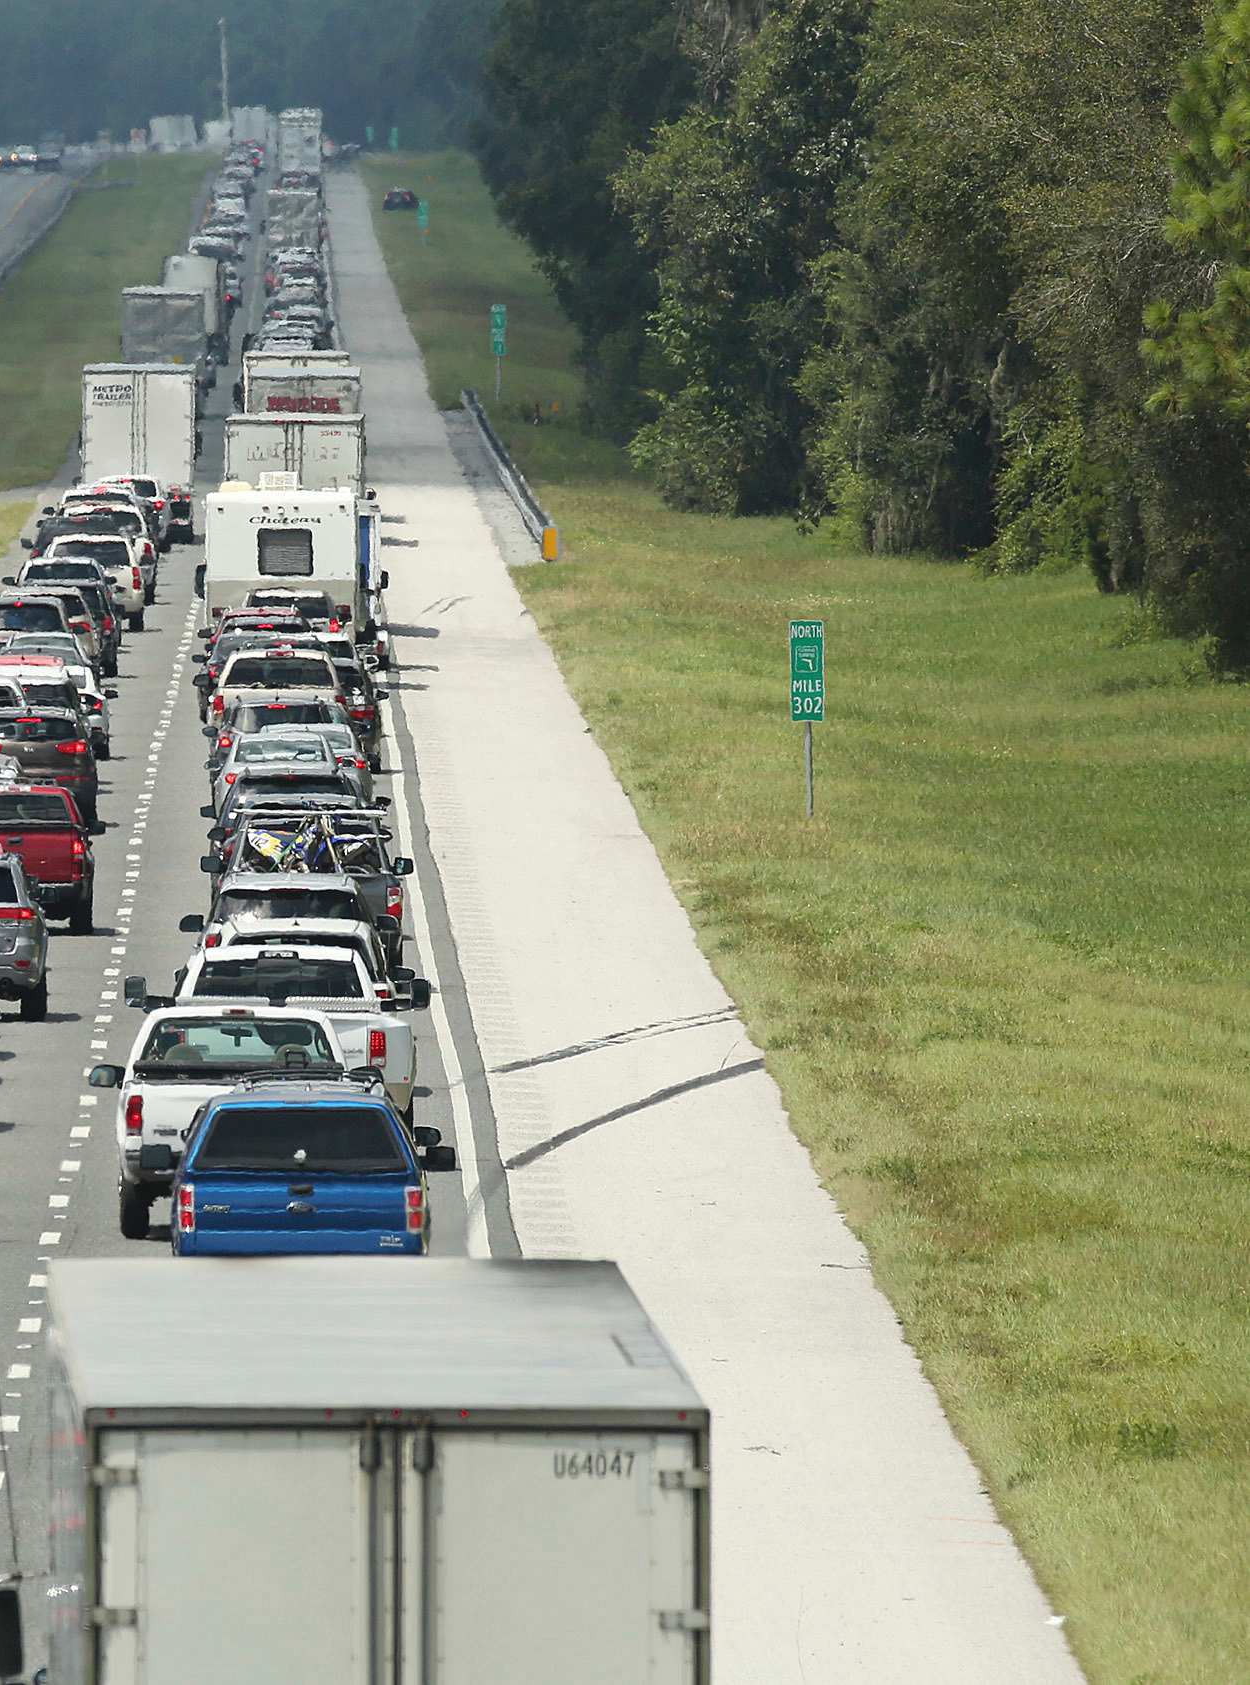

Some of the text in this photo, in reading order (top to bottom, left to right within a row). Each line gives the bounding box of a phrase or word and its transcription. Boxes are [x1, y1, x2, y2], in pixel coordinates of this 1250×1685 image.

[92, 384, 132, 393] METRO
[249, 516, 322, 525] Chateau
[791, 625, 823, 639] NORTH
[792, 680, 822, 693] MILE
[793, 696, 822, 714] 302
[554, 1451, 635, 1479] U64047
